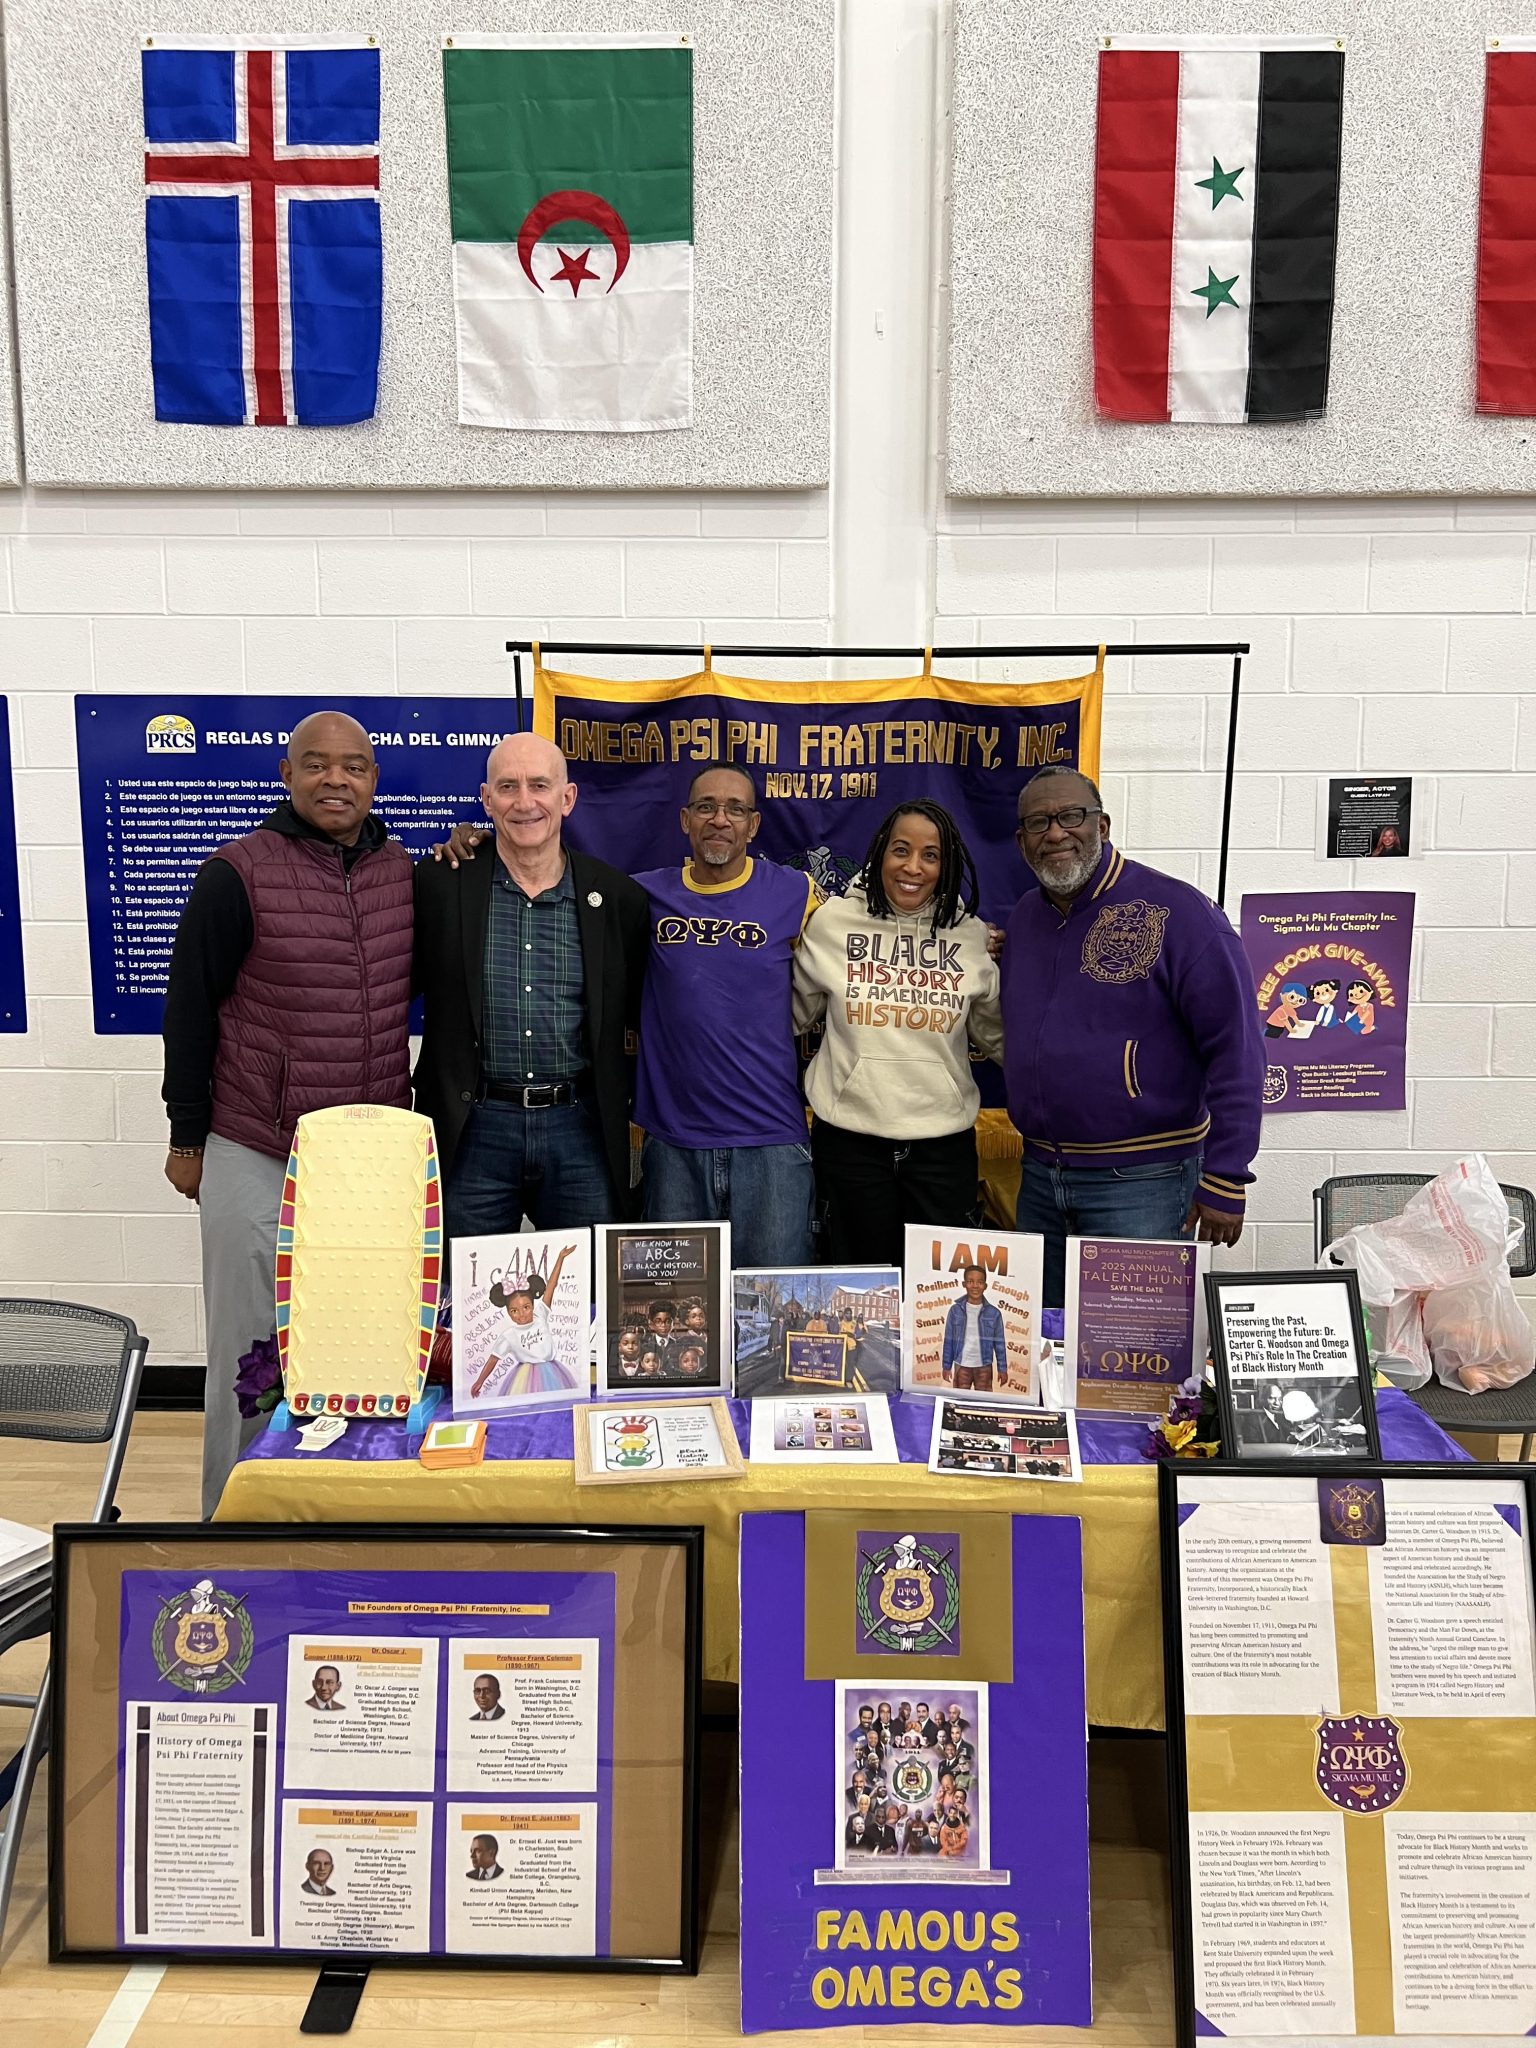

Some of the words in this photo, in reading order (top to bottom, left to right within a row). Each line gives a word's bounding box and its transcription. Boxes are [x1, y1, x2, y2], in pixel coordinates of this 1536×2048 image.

[148, 733, 195, 748] PRCS
[206, 731, 273, 745] REGLAS
[409, 733, 441, 745] DEL
[561, 718, 664, 763] OMEGA
[670, 718, 720, 760] PSI
[726, 720, 778, 765] PHI
[800, 719, 1001, 768] FRATERNITY,
[1017, 722, 1072, 768] INC.
[176, 780, 205, 789] espacio
[218, 780, 239, 789] juego
[241, 780, 257, 789] bajo
[840, 772, 876, 798] 1911
[420, 795, 445, 803] juegos
[145, 910, 180, 918] prohibido
[1259, 915, 1292, 924] Omega
[1296, 914, 1308, 922] Psi
[1312, 913, 1327, 921] Phi
[1330, 912, 1377, 922] Fraternity
[657, 916, 767, 949] ΩΨΦ
[1274, 924, 1302, 934] Sigma
[1306, 924, 1320, 932] Mu
[1324, 923, 1338, 931] Mu
[1342, 923, 1380, 932] Chapter
[846, 933, 964, 972] BLACK
[847, 962, 965, 991] HISTORY
[1257, 973, 1280, 1010] FREE
[1274, 944, 1321, 976] BOOK
[1324, 943, 1395, 1007] GIVE-AWAY
[867, 986, 965, 1010] AMERICAN
[846, 1001, 961, 1033] HISTORY
[635, 1240, 648, 1248] WE
[645, 1248, 680, 1261] ABCs
[932, 1240, 941, 1271] I
[1101, 1262, 1125, 1271] 2025
[1128, 1263, 1173, 1273] ANNUAL
[1082, 1271, 1141, 1283] TALENT
[1149, 1274, 1192, 1285] HUNT
[916, 1279, 959, 1293] Resilient
[992, 1281, 1029, 1302] Enough
[916, 1296, 953, 1311] Capable
[998, 1300, 1029, 1320] Strong
[464, 1300, 491, 1322] LOVED
[916, 1316, 945, 1328] Smart
[1226, 1317, 1270, 1327] Preserving
[1272, 1317, 1285, 1325] the
[1287, 1316, 1307, 1325] Past,
[1005, 1322, 1029, 1336] Equal
[1228, 1328, 1276, 1339] Empowering
[1279, 1328, 1291, 1337] the
[1294, 1327, 1322, 1336] Future:
[1324, 1327, 1335, 1335] Dr.
[1007, 1342, 1028, 1356] Safe
[1229, 1340, 1254, 1349] Carter
[1257, 1340, 1265, 1348] G.
[1268, 1339, 1303, 1348] Woodson
[1305, 1338, 1319, 1347] and
[1322, 1338, 1349, 1349] Omega
[916, 1352, 940, 1364] Kind
[1100, 1351, 1170, 1374] ΩΨΦ
[1231, 1352, 1243, 1361] Psi
[1245, 1351, 1264, 1360] Phi's
[1267, 1350, 1284, 1360] Role
[1287, 1351, 1294, 1359] In
[1296, 1350, 1310, 1359] The
[1313, 1350, 1347, 1359] Creation
[1232, 1363, 1239, 1373] of
[1242, 1363, 1265, 1372] Black
[1267, 1362, 1296, 1373] History
[1299, 1362, 1324, 1371] Month
[1008, 1379, 1027, 1393] Fun
[401, 1402, 406, 1410] 7
[157, 1712, 179, 1722] About
[181, 1713, 207, 1724] Omega
[210, 1713, 221, 1722] Psi
[223, 1713, 235, 1723] Phi
[157, 1737, 192, 1747] History
[196, 1738, 205, 1746] of
[209, 1738, 242, 1748] Omega
[174, 1751, 189, 1759] Phi
[193, 1751, 243, 1761] Fraternity
[1330, 1746, 1391, 1770] ΩΨΦ
[1332, 1773, 1359, 1782] SIGMA
[1377, 1774, 1392, 1782] MU
[815, 1908, 1021, 1953] FAMOUS
[811, 1959, 1024, 2011] OMEGA'S
